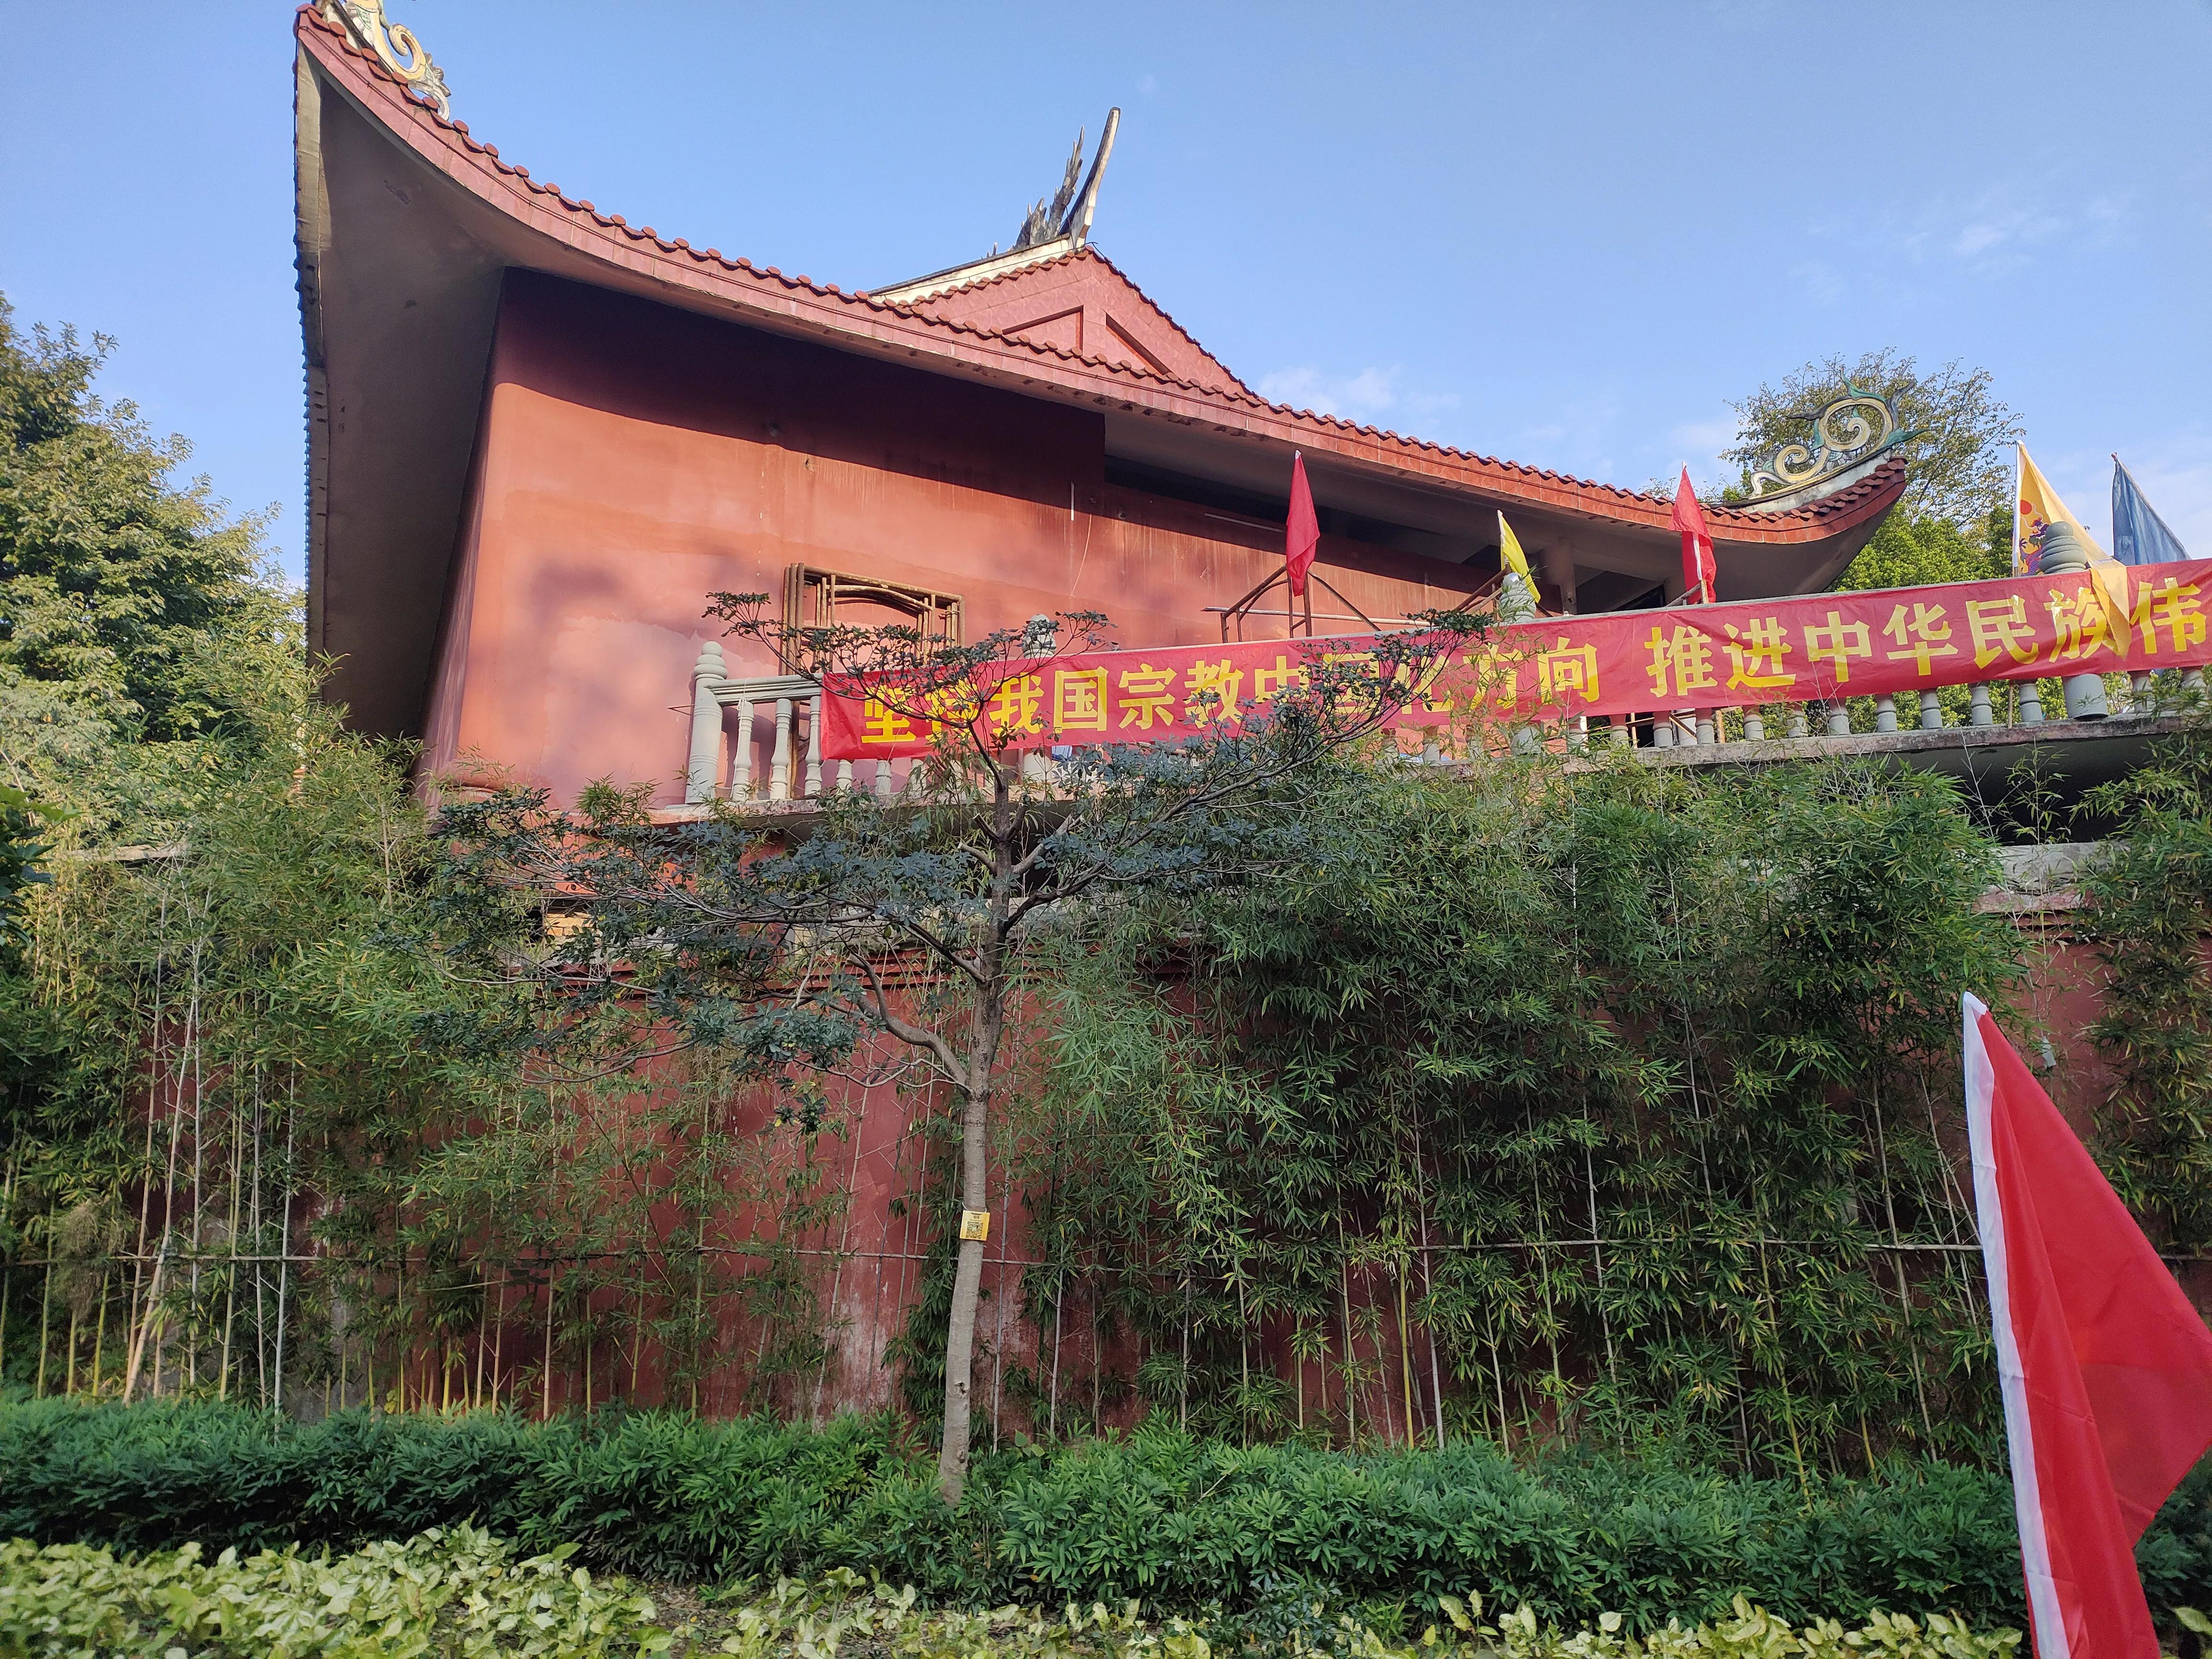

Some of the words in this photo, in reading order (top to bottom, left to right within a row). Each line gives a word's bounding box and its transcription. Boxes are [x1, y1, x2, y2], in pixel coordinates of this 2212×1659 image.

[1644, 576, 2207, 698] 推进中华民族伟
